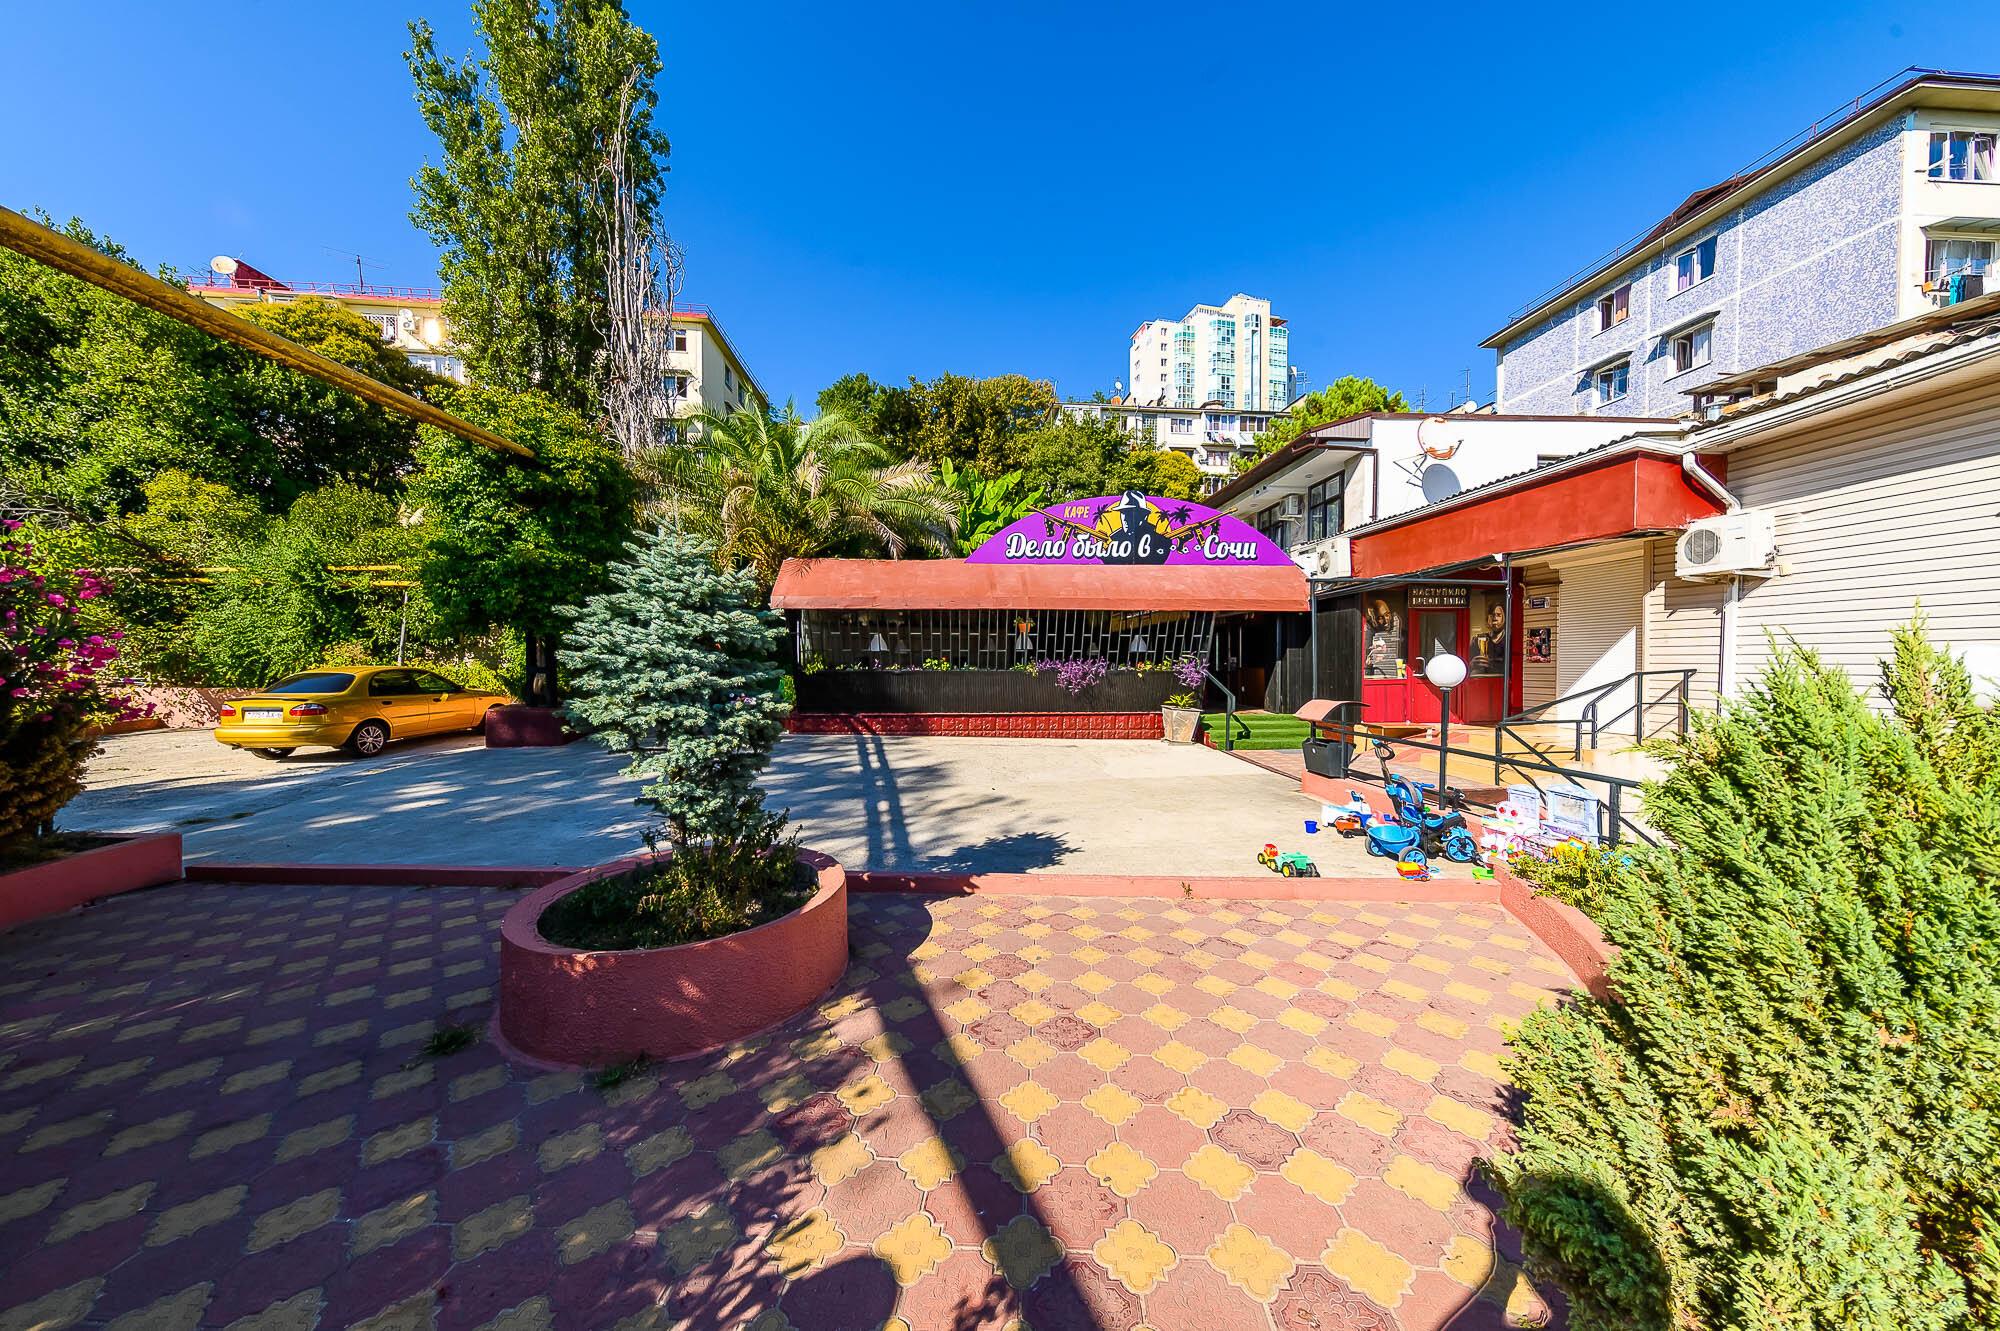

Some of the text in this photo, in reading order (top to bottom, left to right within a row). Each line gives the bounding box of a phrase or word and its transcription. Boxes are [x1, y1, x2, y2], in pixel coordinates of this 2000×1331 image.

[1064, 506, 1089, 518] КАФЕ
[1005, 532, 1066, 558] Дело
[1072, 533, 1131, 558] было
[1203, 534, 1257, 559] Сочи
[1412, 588, 1466, 596] НАСТУПИЛО
